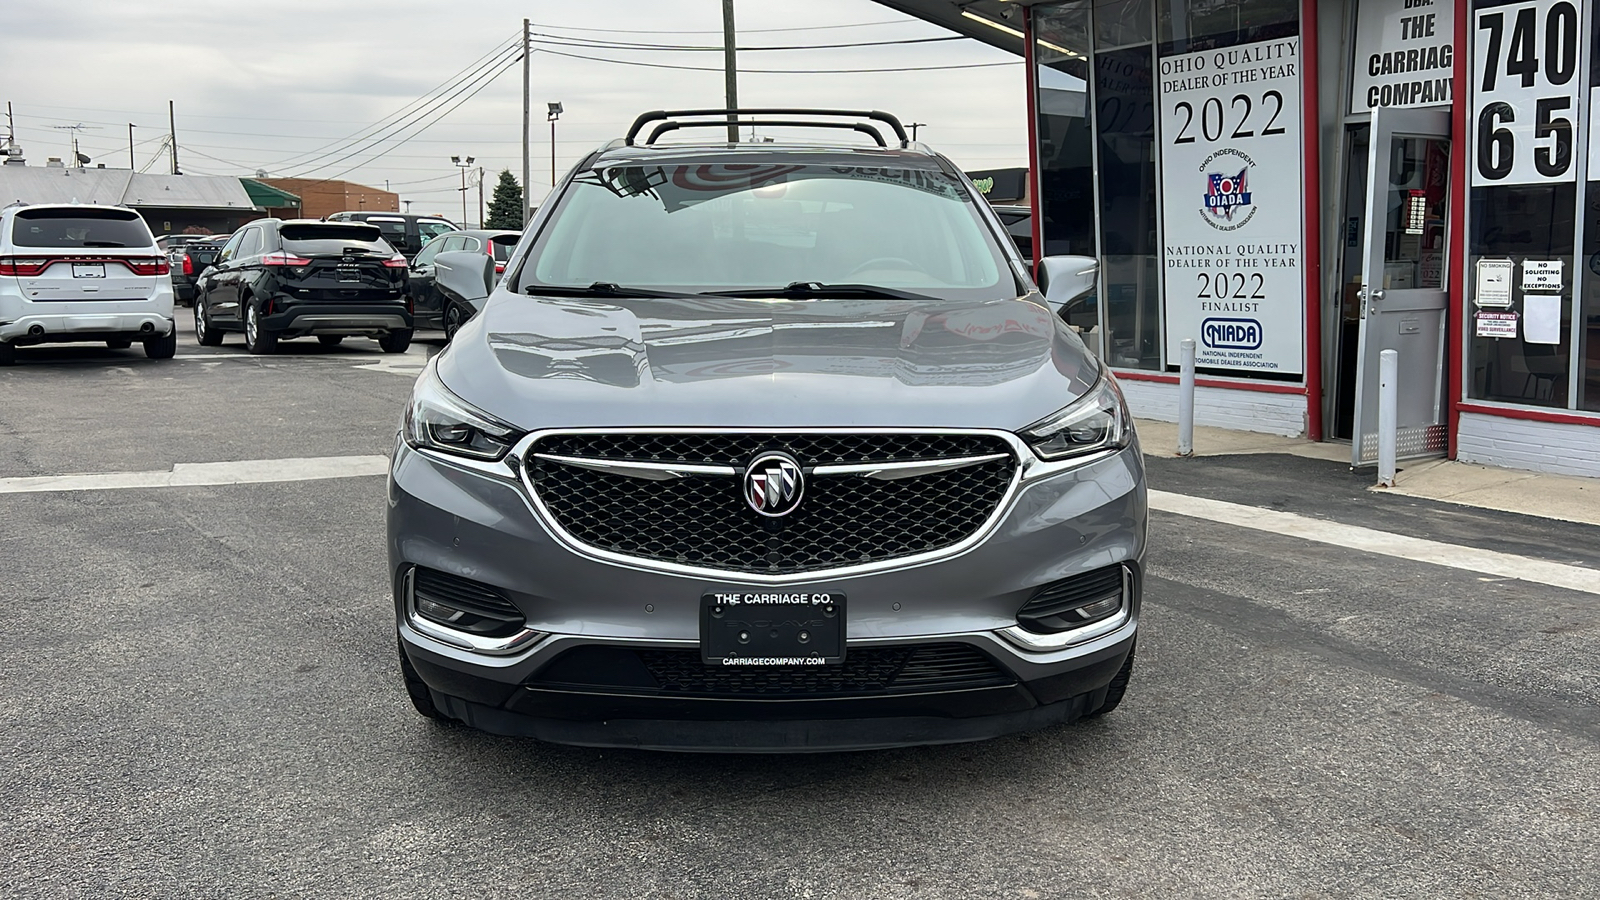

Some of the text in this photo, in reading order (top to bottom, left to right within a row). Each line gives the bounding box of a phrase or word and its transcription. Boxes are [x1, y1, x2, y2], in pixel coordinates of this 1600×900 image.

[1400, 13, 1436, 40] THE
[1161, 41, 1298, 75] OHIO QUALITY
[1479, 1, 1577, 92] 740
[1368, 44, 1453, 77] CARRIAG
[1163, 76, 1209, 93] DEALER
[1212, 73, 1228, 87] OF
[1231, 69, 1257, 84] THE
[1260, 63, 1296, 80] YEAR
[1174, 90, 1285, 144] 2022
[1199, 148, 1256, 172] OHIO INDEPENDENT
[1209, 194, 1244, 206] OIADA
[1167, 244, 1297, 256] NATIONAL QUALITY
[1168, 258, 1296, 268] DEALER OF THE YEAR
[1197, 272, 1265, 299] 2022
[1202, 302, 1259, 312] FINALIST
[1206, 325, 1256, 343] NIADA
[715, 593, 834, 604] THE CARRIAGE CO.
[722, 658, 826, 666] CARRIAGECOMPANY.COM
